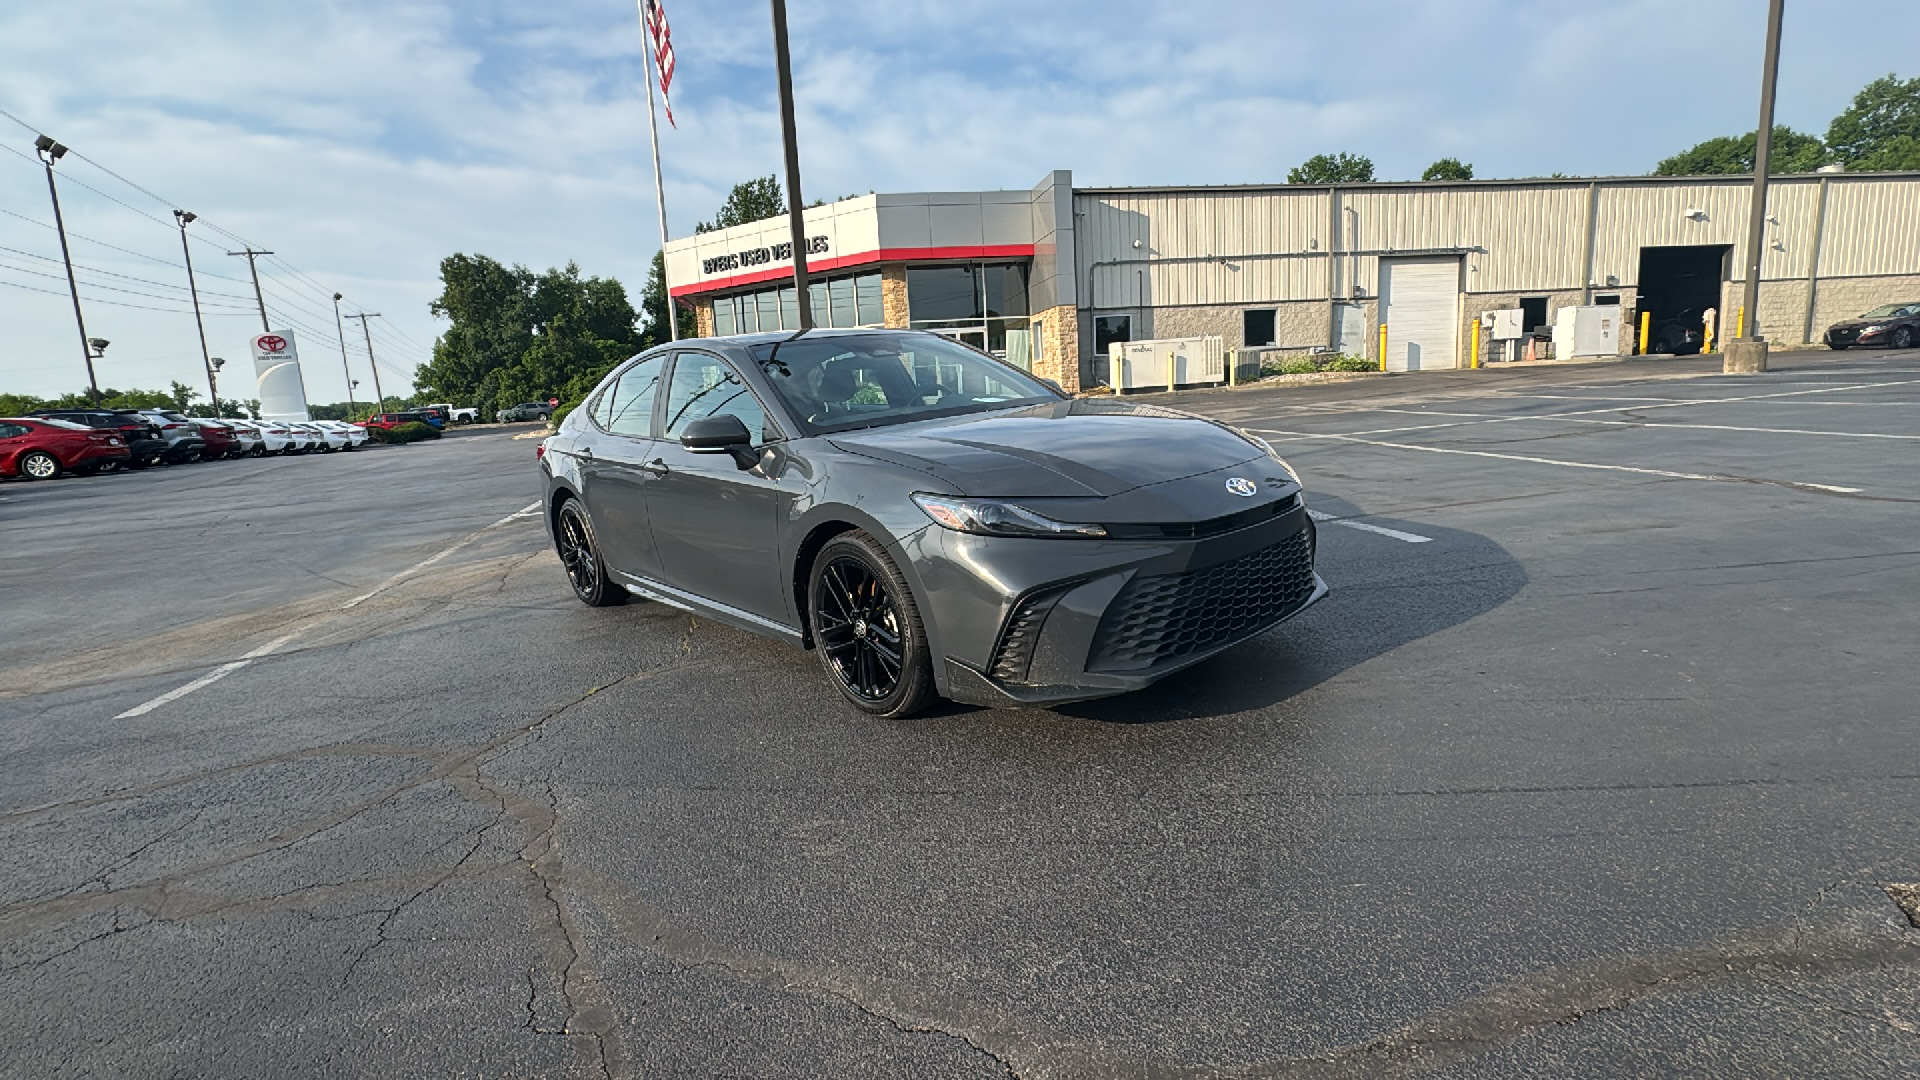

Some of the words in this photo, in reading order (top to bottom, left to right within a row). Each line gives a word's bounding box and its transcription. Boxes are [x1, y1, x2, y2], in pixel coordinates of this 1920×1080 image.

[703, 254, 738, 274] BYERS
[738, 247, 770, 267] USED
[770, 234, 829, 261] VEHLES
